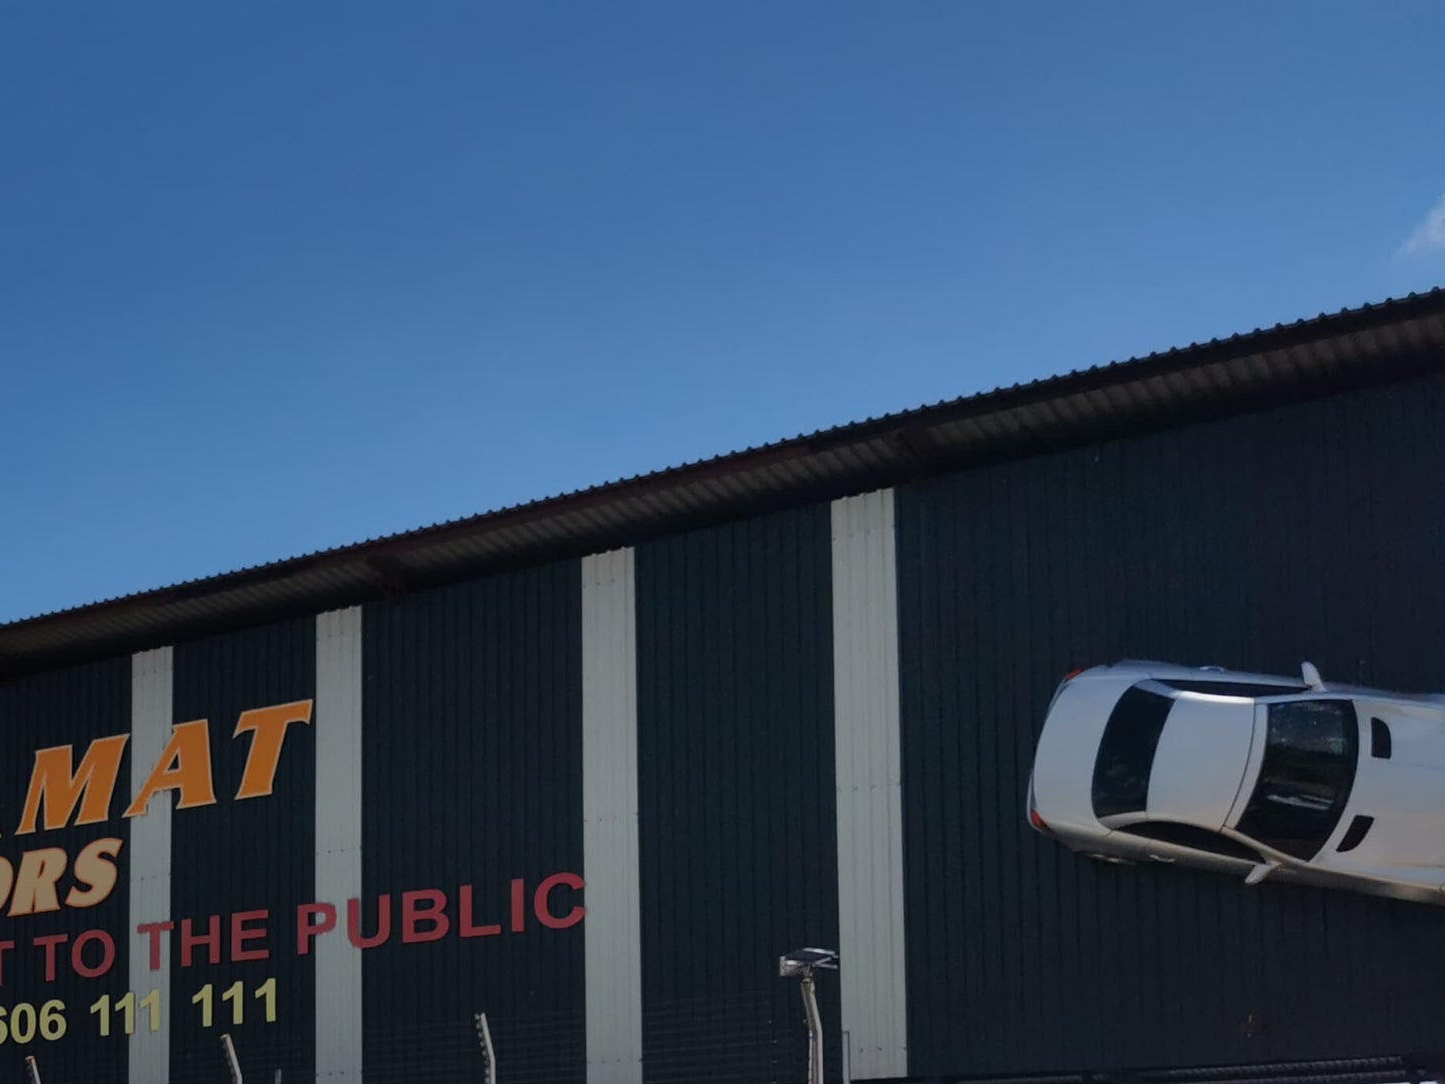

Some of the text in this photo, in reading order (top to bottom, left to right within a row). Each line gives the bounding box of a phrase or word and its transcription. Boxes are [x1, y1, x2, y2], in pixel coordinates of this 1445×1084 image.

[33, 929, 116, 982] TO
[137, 908, 270, 972] THE
[296, 872, 587, 956] PUBLIC
[90, 988, 161, 1037] 111
[192, 978, 277, 1028] 111
